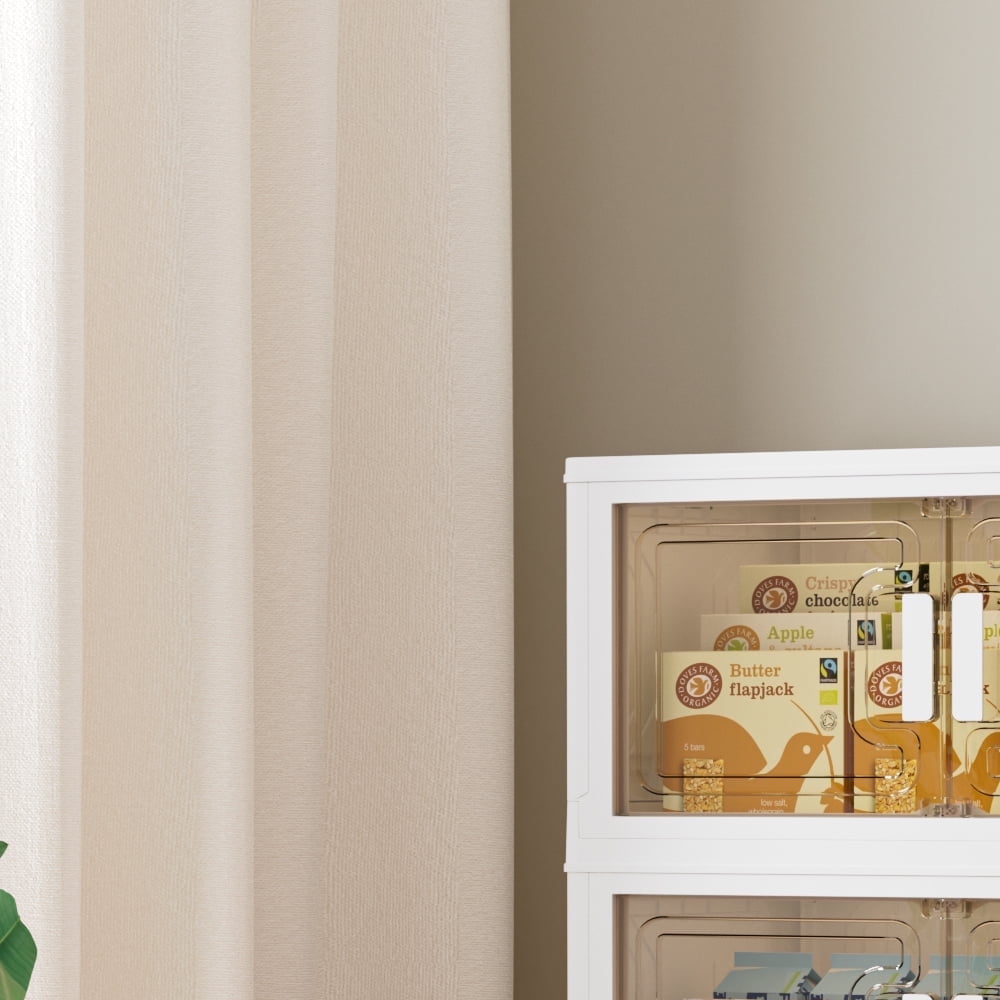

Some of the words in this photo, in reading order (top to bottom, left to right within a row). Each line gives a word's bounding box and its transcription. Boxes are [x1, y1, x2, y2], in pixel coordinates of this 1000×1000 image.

[767, 625, 815, 642] Apple
[677, 666, 697, 694] DOVES
[699, 665, 719, 682] FARM
[730, 663, 782, 678] Butter
[869, 665, 890, 693] DOVES
[683, 686, 720, 707] ORGANIC
[729, 682, 795, 700] flapjack
